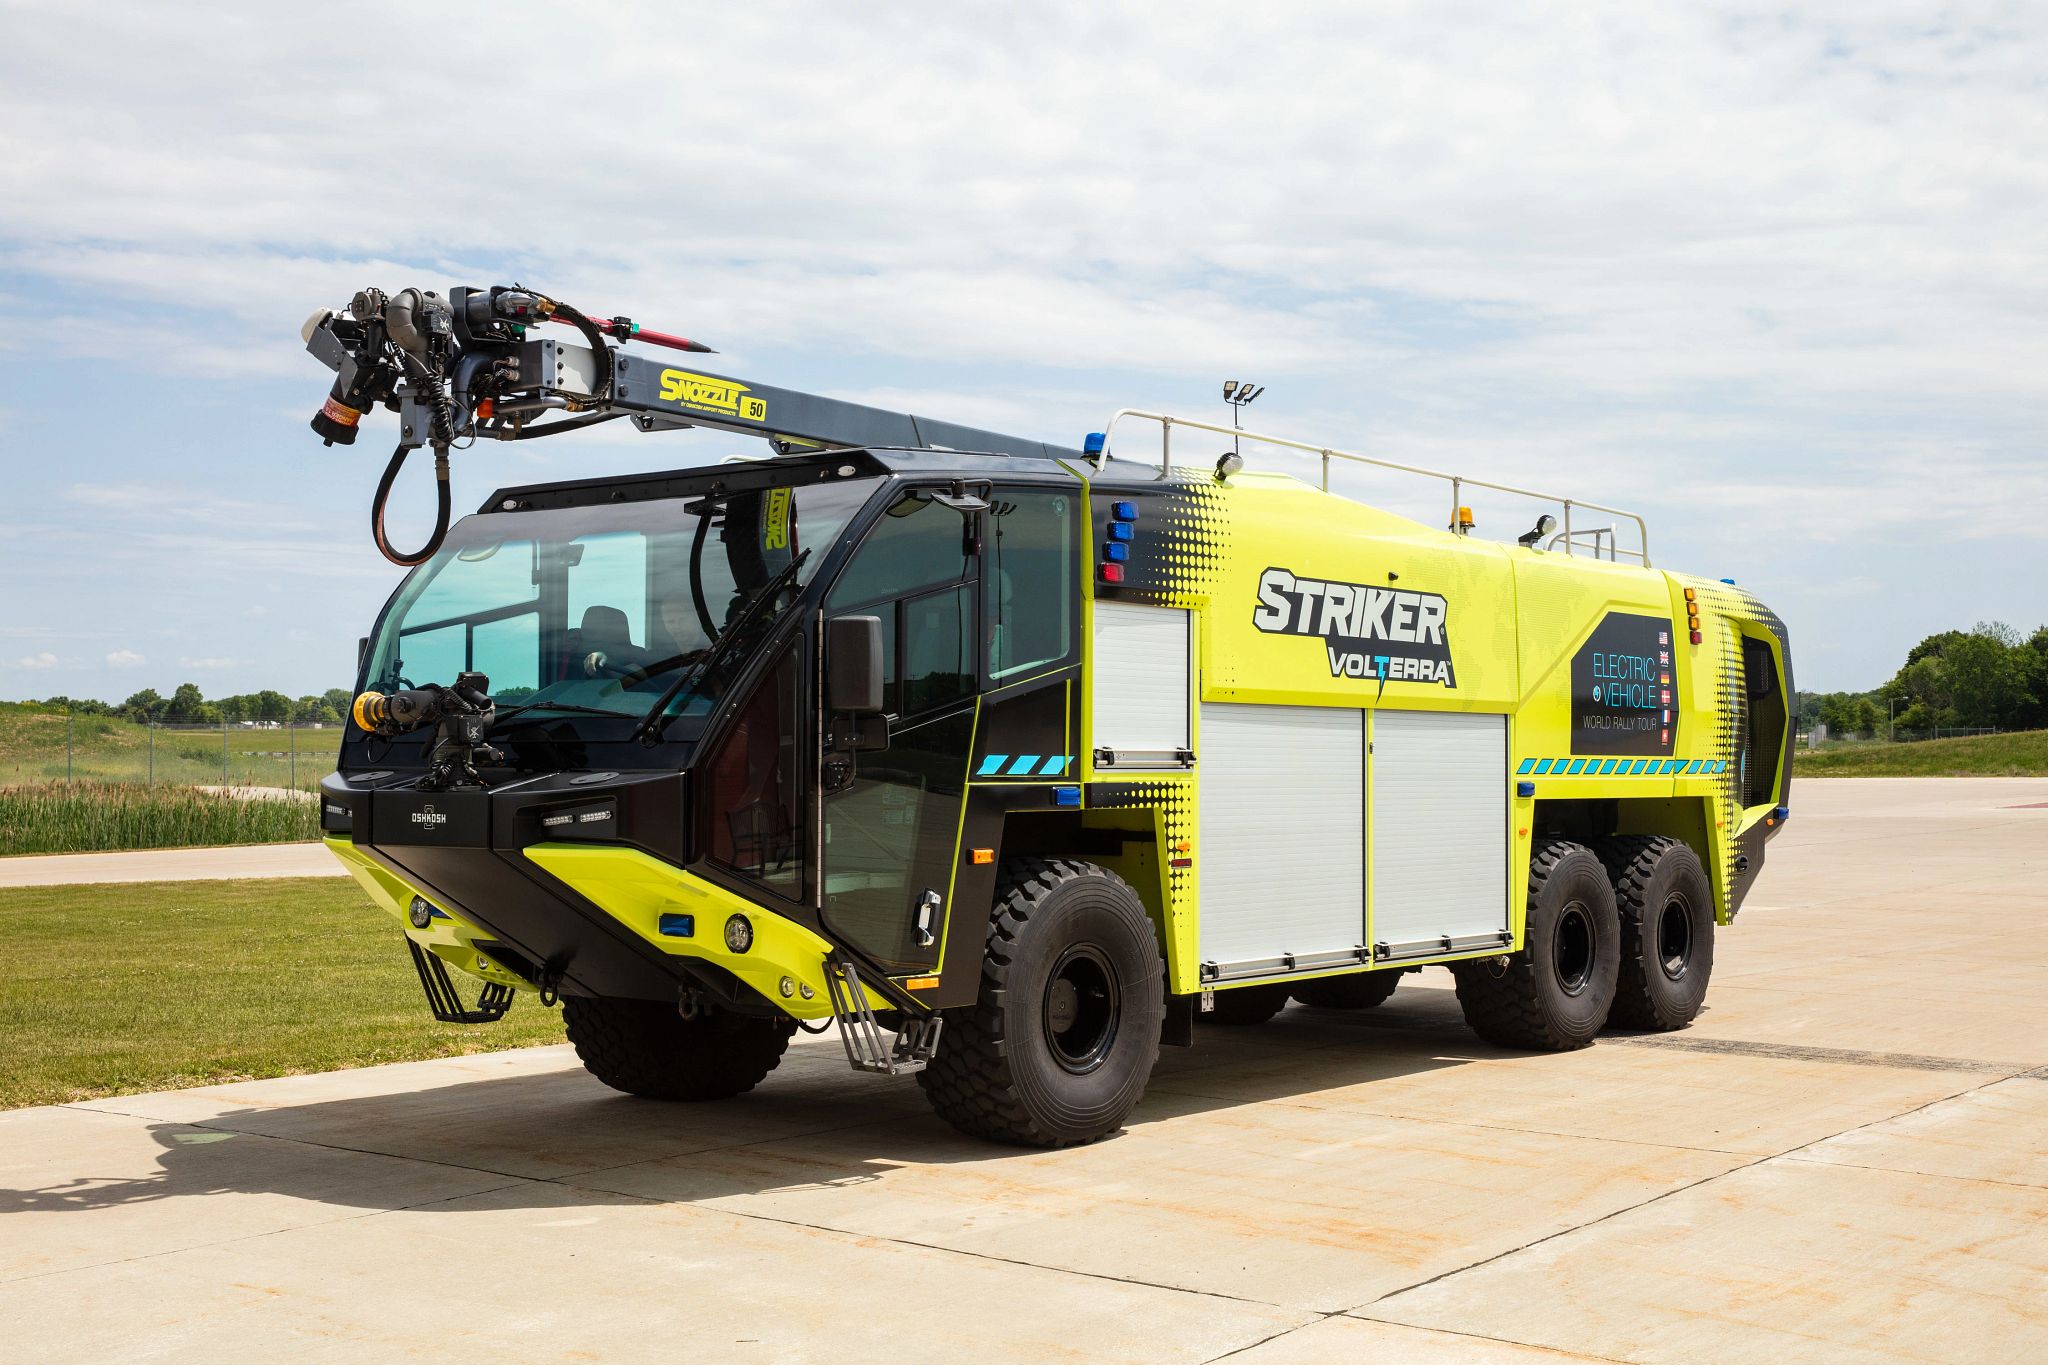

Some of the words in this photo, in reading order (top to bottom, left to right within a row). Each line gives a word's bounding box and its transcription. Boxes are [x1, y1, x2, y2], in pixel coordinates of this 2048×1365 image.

[659, 368, 752, 410] SNOZZLE
[750, 402, 764, 417] 50
[1254, 569, 1448, 645] STRIKER
[1327, 646, 1451, 688] VOLTERRA
[1593, 652, 1656, 681] ELECTRIC
[1602, 682, 1657, 709] VEHICLE
[1583, 715, 1611, 730] WORLD
[1614, 716, 1636, 731] RALLY
[1638, 717, 1657, 731] TOUR
[411, 812, 447, 824] OSHKOSH
